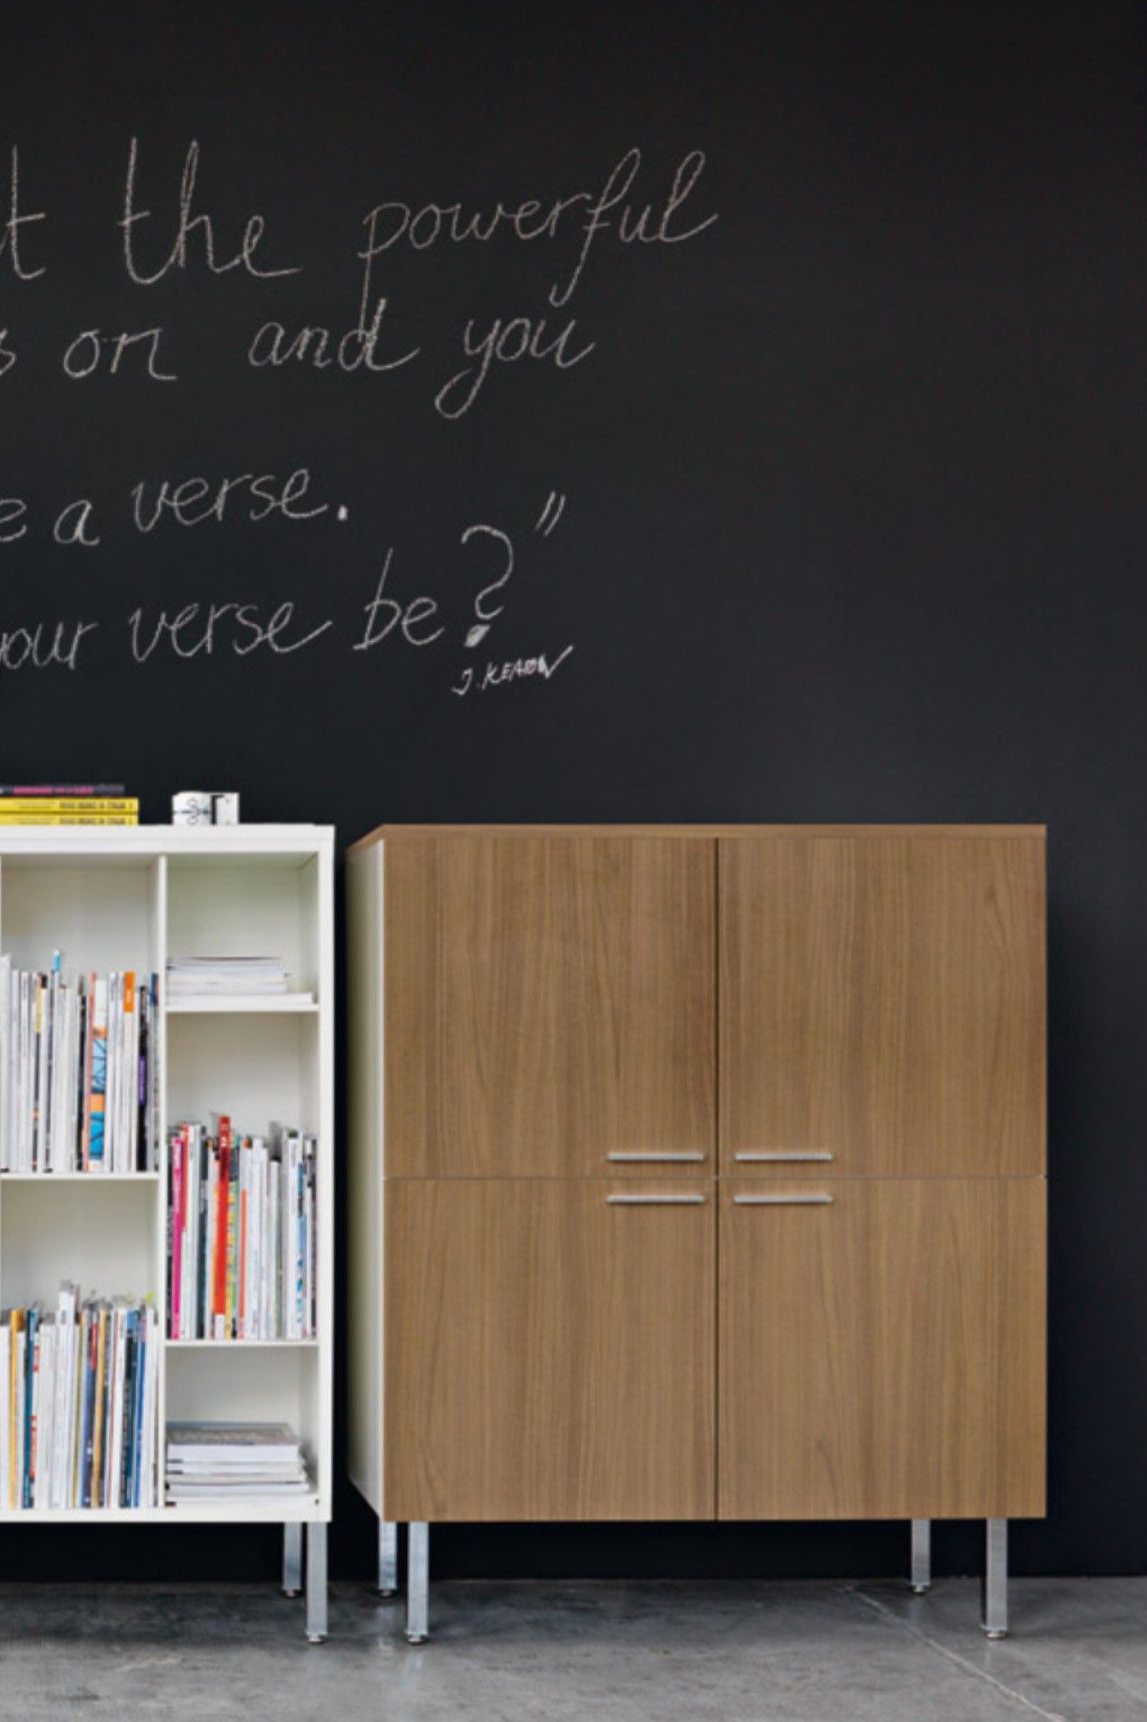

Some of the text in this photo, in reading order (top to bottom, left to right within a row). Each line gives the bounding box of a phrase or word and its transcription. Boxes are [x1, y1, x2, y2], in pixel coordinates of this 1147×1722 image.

[118, 137, 300, 285] the
[357, 147, 719, 342] powerful
[62, 328, 178, 381] on
[249, 299, 420, 371] and
[435, 317, 596, 419] you
[54, 499, 101, 547] a
[132, 469, 349, 533] verse.
[129, 601, 333, 663] verse
